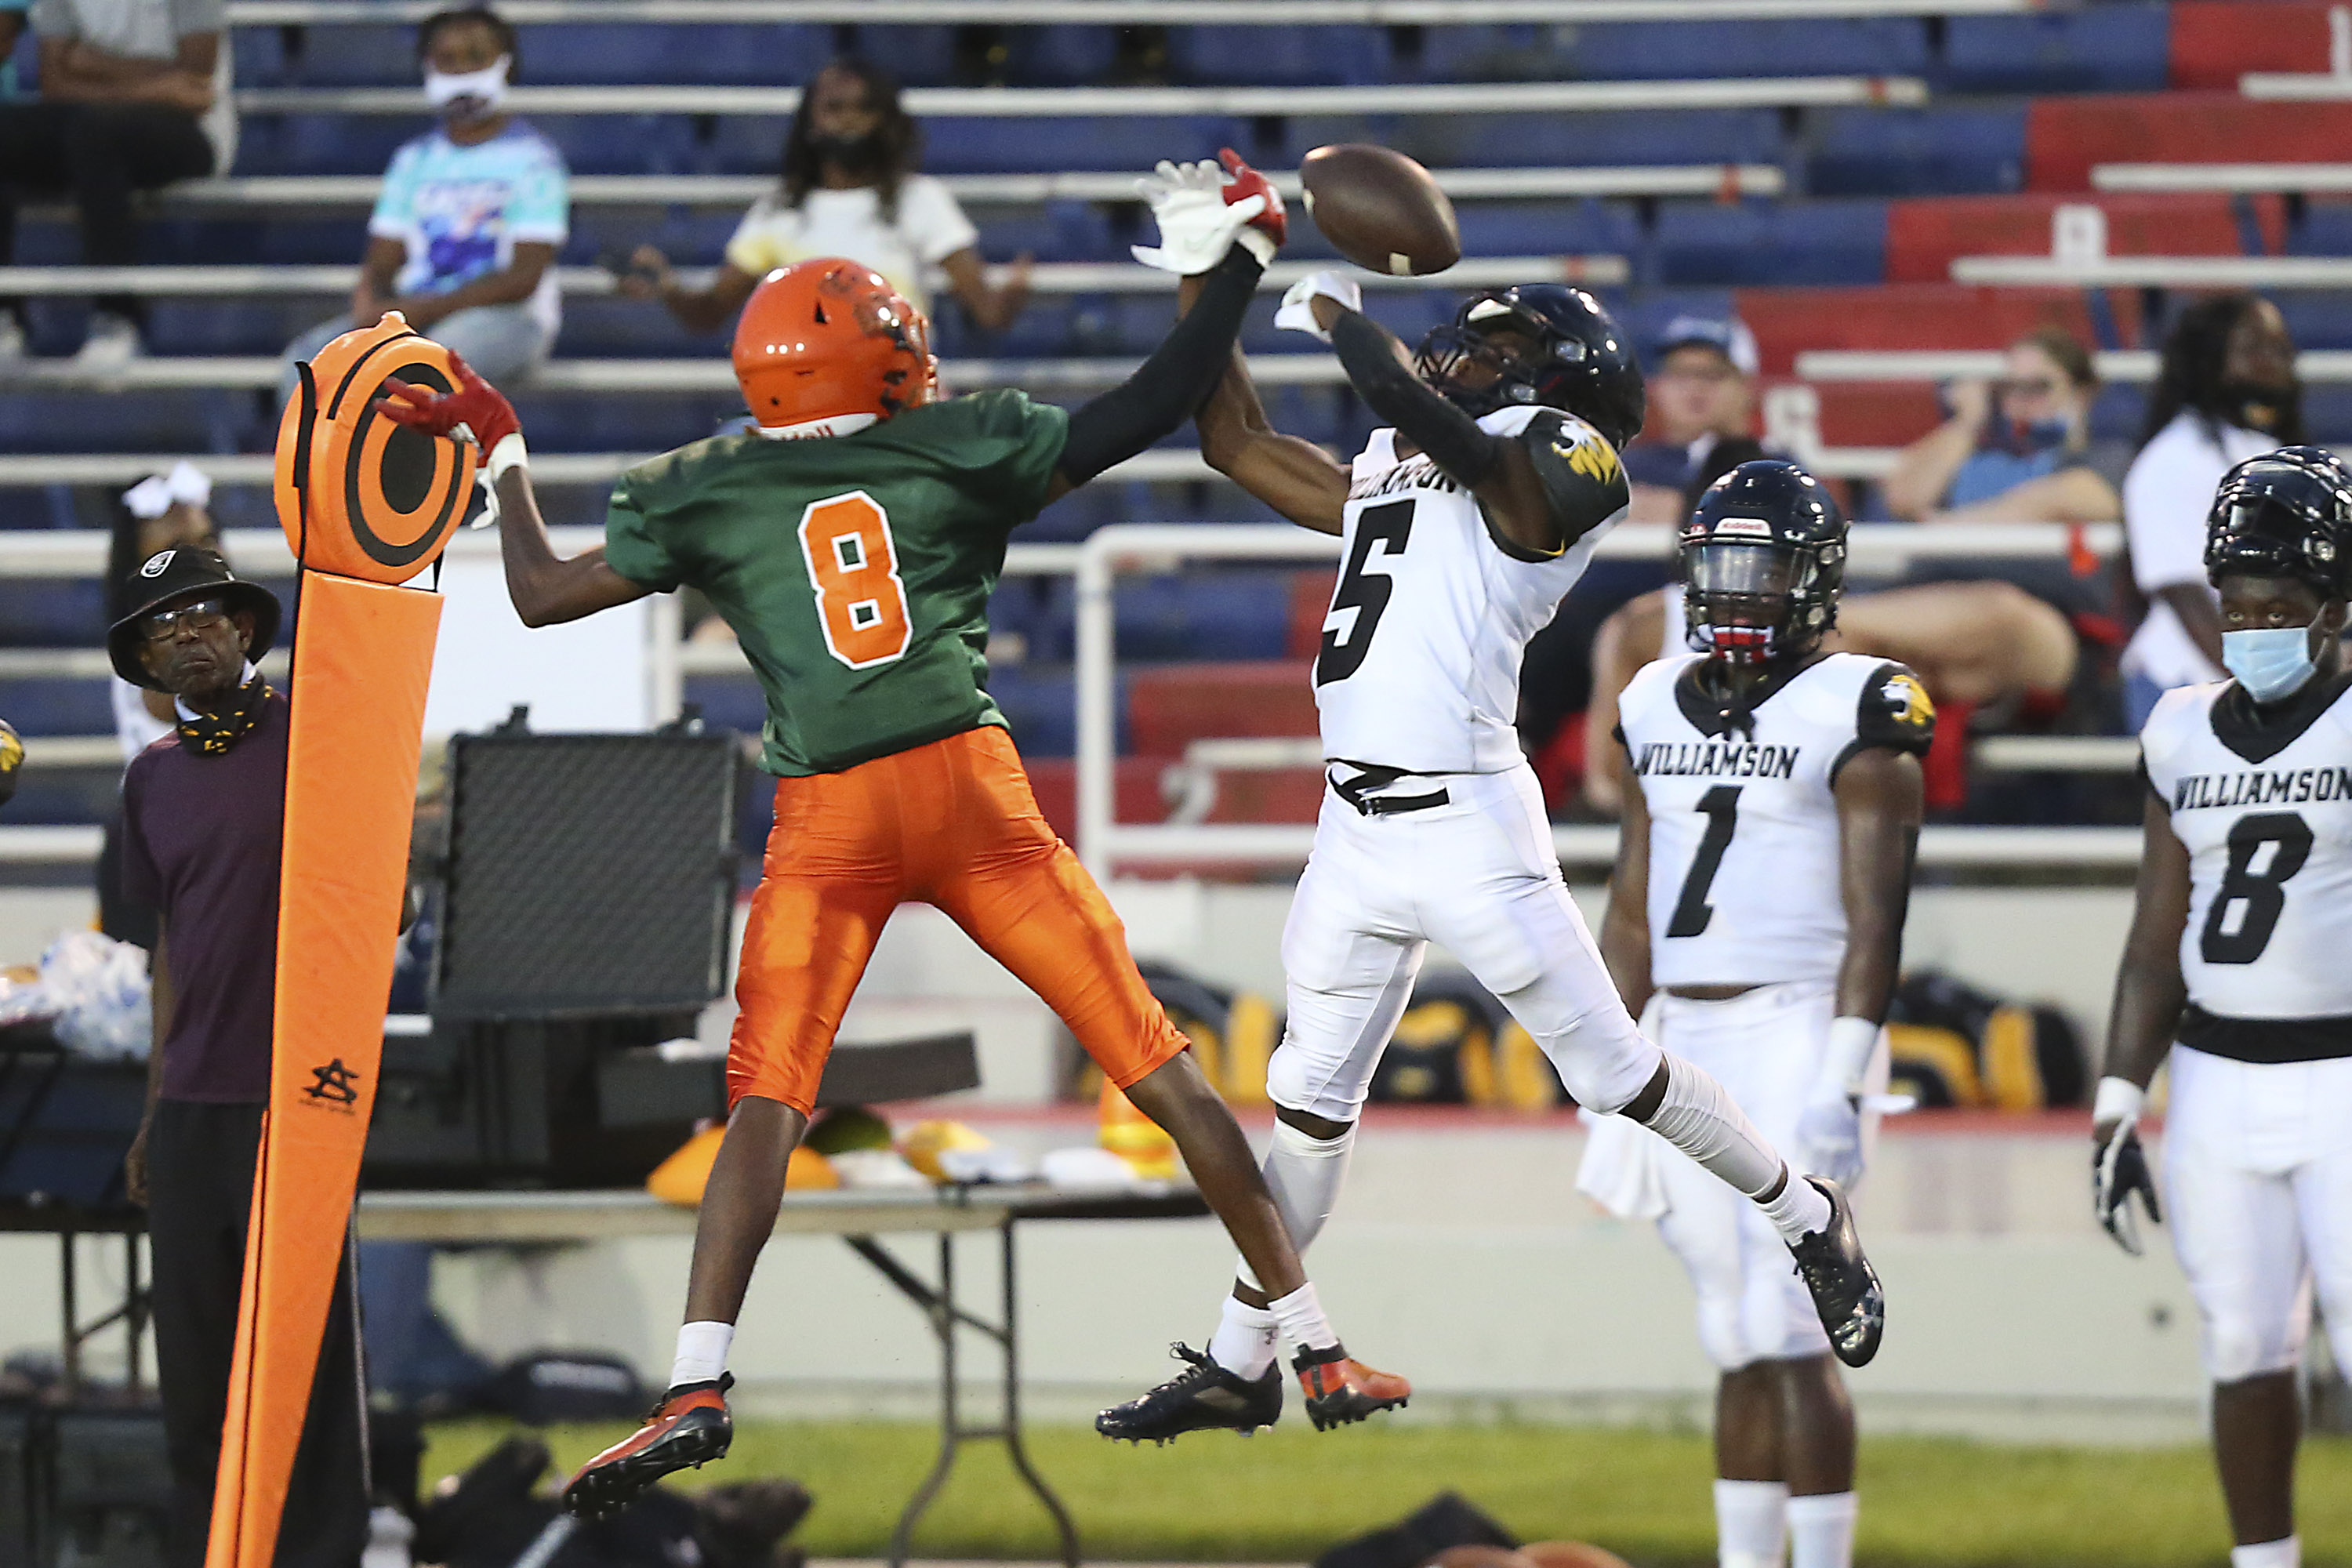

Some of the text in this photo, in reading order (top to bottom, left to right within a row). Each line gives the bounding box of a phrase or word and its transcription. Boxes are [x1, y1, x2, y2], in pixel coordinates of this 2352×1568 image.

[797, 490, 913, 671] 8
[1316, 499, 1416, 688] 5
[1635, 742, 1801, 779] WILLIAMSON
[2173, 765, 2352, 811] WILLIAMSON
[1666, 785, 1745, 938] 1
[2200, 812, 2315, 964] 8
